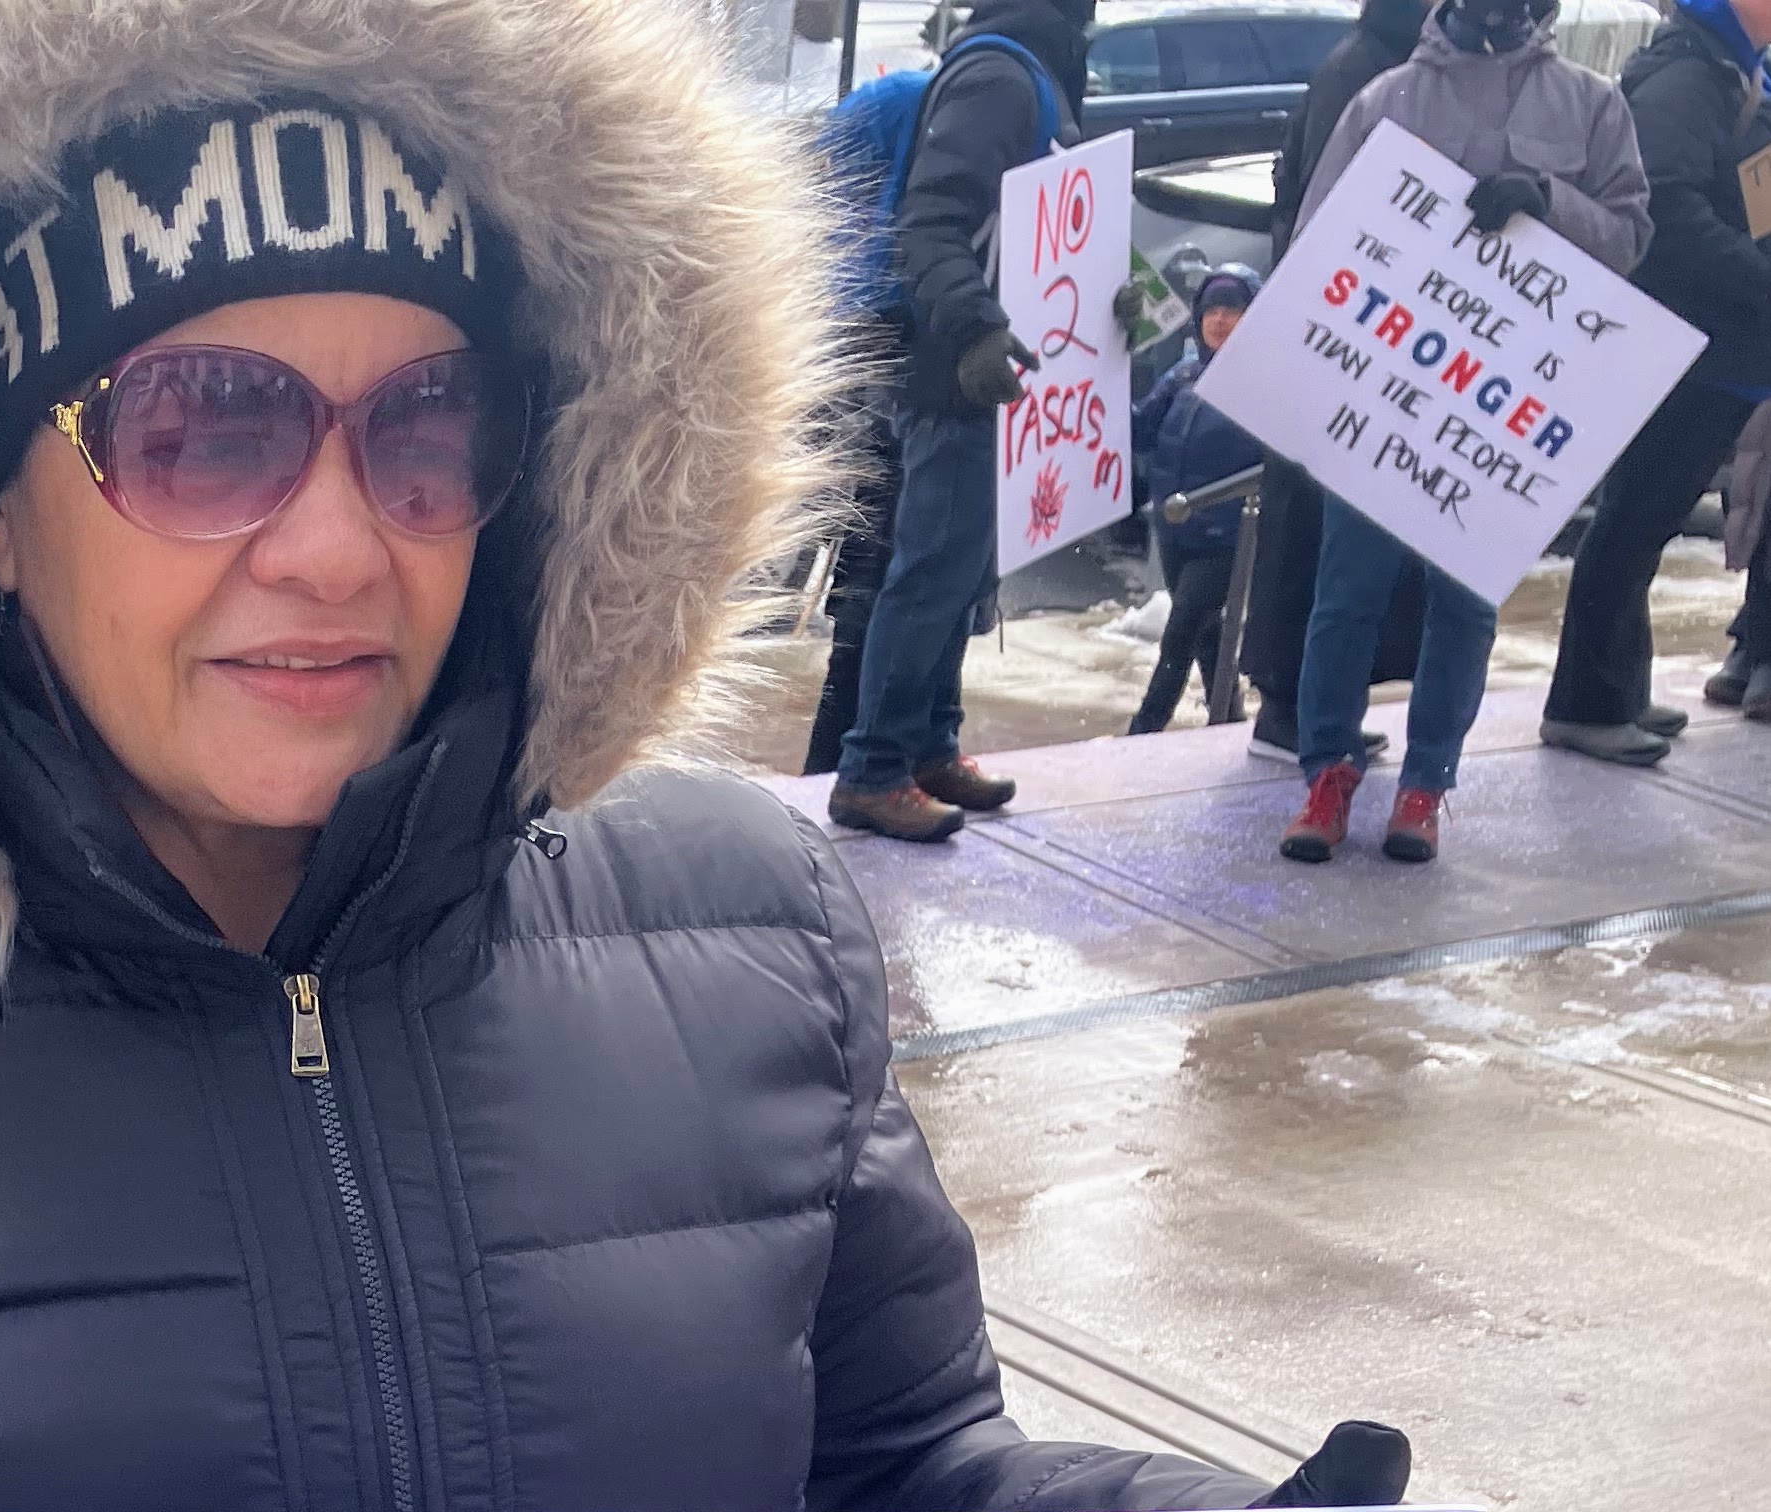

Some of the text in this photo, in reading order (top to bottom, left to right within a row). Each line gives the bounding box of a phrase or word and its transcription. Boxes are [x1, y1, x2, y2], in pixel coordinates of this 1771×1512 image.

[92, 107, 480, 311] MOM
[1033, 167, 1095, 277] NO
[1388, 168, 1452, 230] THE
[1452, 218, 1569, 322] POWER
[1041, 274, 1099, 359] 2
[1323, 267, 1574, 459] STRONGER
[1353, 228, 1565, 382] THE PEOPLE IS
[1303, 318, 1559, 507] THAN THE PEOPLE
[1326, 402, 1471, 532] IN POWER
